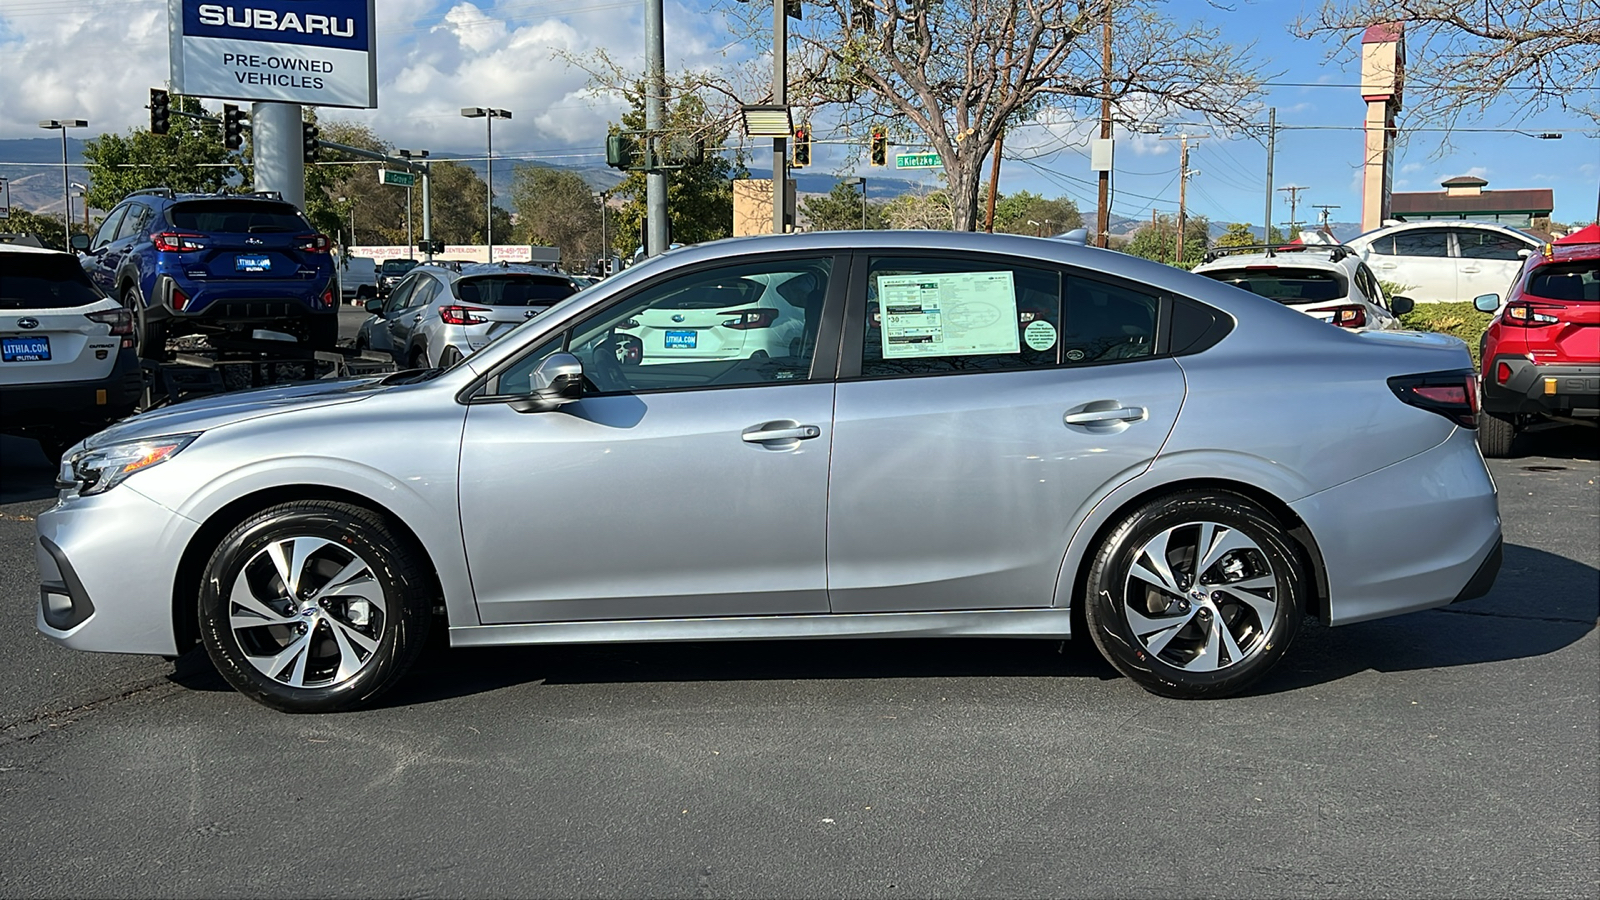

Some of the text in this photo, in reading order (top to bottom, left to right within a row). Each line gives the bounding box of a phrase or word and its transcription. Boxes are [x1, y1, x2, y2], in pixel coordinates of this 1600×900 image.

[199, 4, 354, 38] SUBARU
[223, 53, 334, 74] PRE-OWNED
[234, 71, 324, 90] VEHICLES
[904, 156, 933, 166] Kietzke
[393, 174, 408, 184] Grove
[493, 247, 530, 255] 775-451-7021
[237, 258, 271, 267] LITHIA.COM
[666, 336, 696, 344] LITHIA.COM
[3, 343, 49, 354] LITHIA.COM
